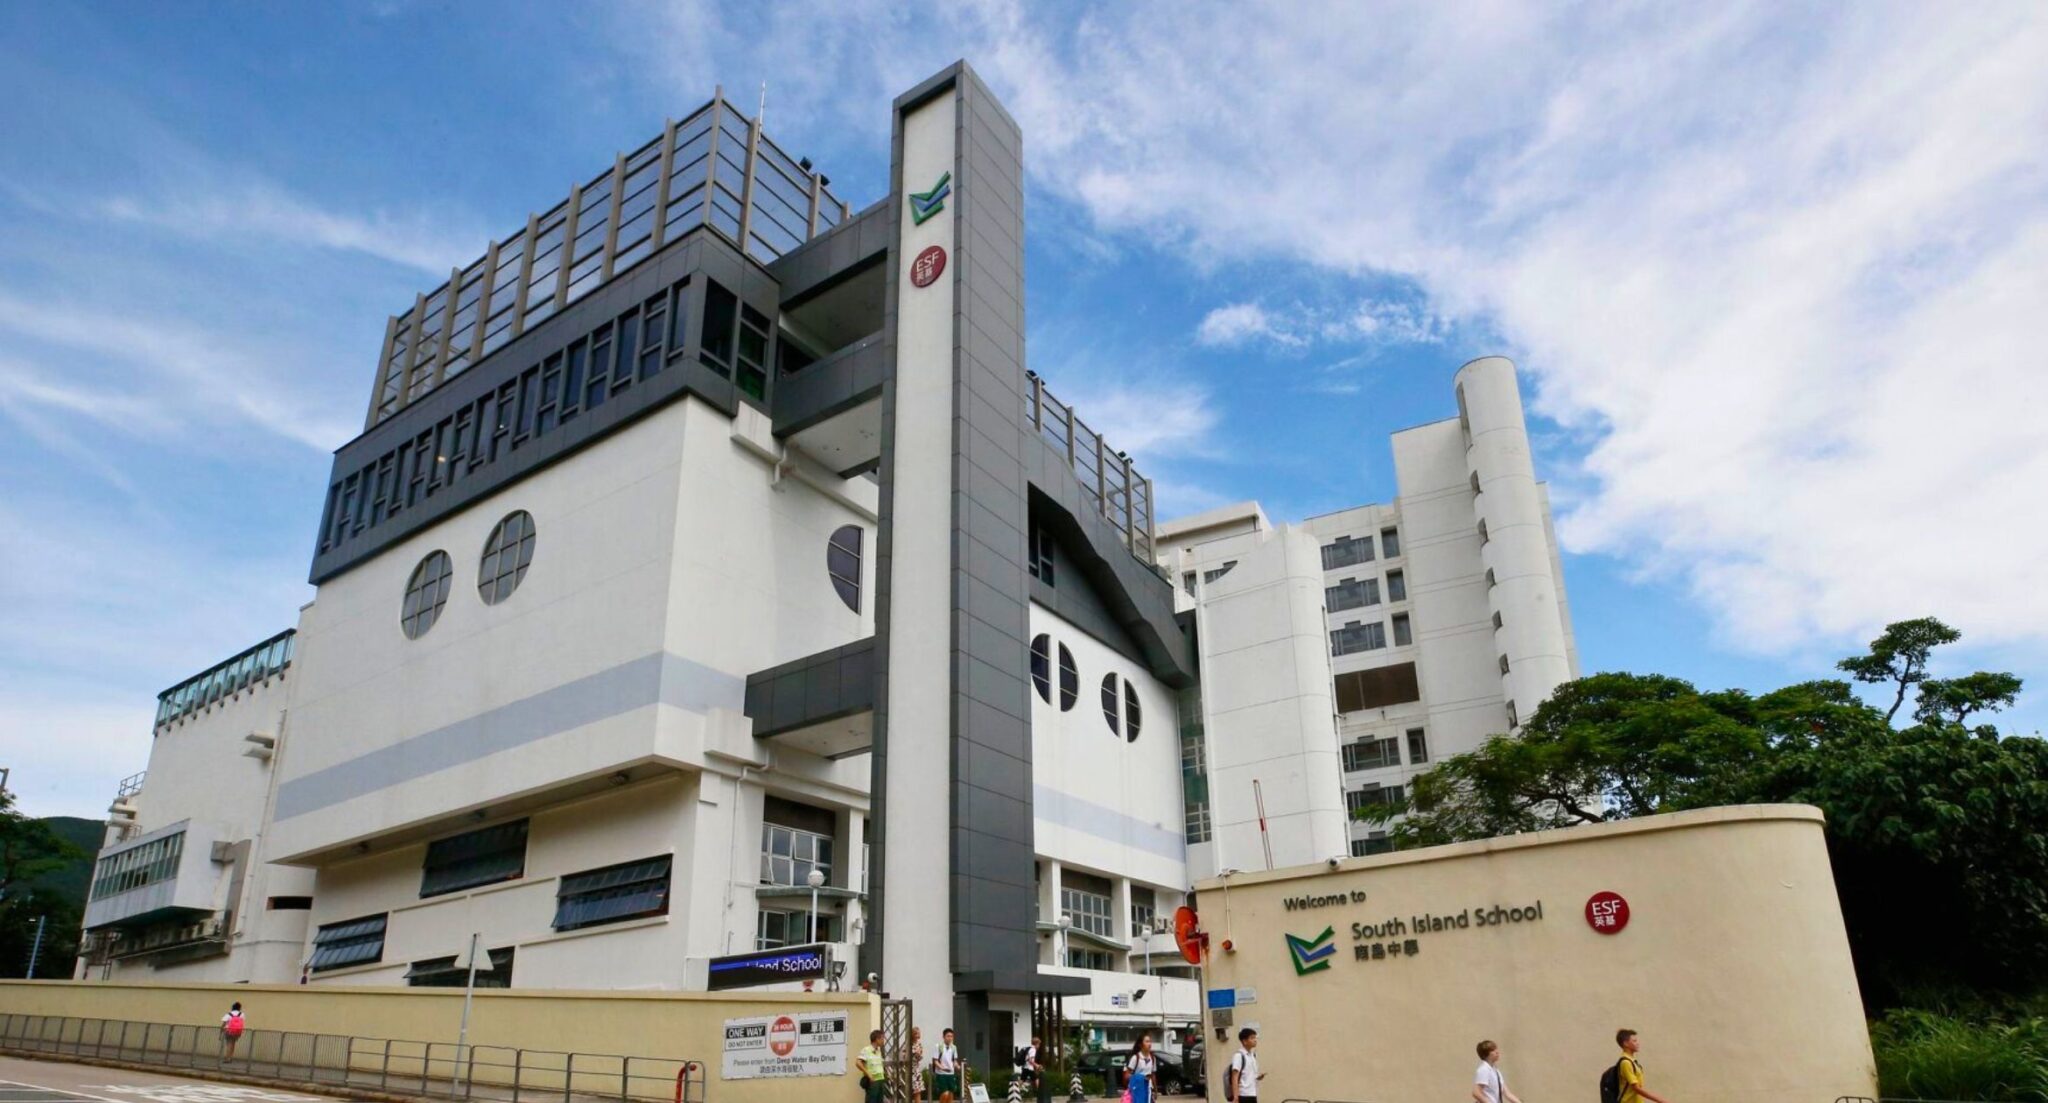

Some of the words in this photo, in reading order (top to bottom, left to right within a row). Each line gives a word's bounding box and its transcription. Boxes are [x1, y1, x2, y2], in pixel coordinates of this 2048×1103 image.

[916, 251, 940, 272] ESF
[1284, 894, 1347, 911] Welcome
[1350, 890, 1366, 903] to
[1592, 900, 1620, 915] ESF
[1351, 917, 1407, 940] South
[1412, 909, 1469, 934] Island
[1474, 900, 1543, 927] School
[1594, 915, 1616, 927] 英基
[1354, 939, 1419, 961] 南島中學
[782, 954, 822, 972] School
[728, 1029, 745, 1038] ONE
[746, 1027, 763, 1037] WAY
[777, 1057, 790, 1065] Deep
[809, 1056, 819, 1064] Bay
